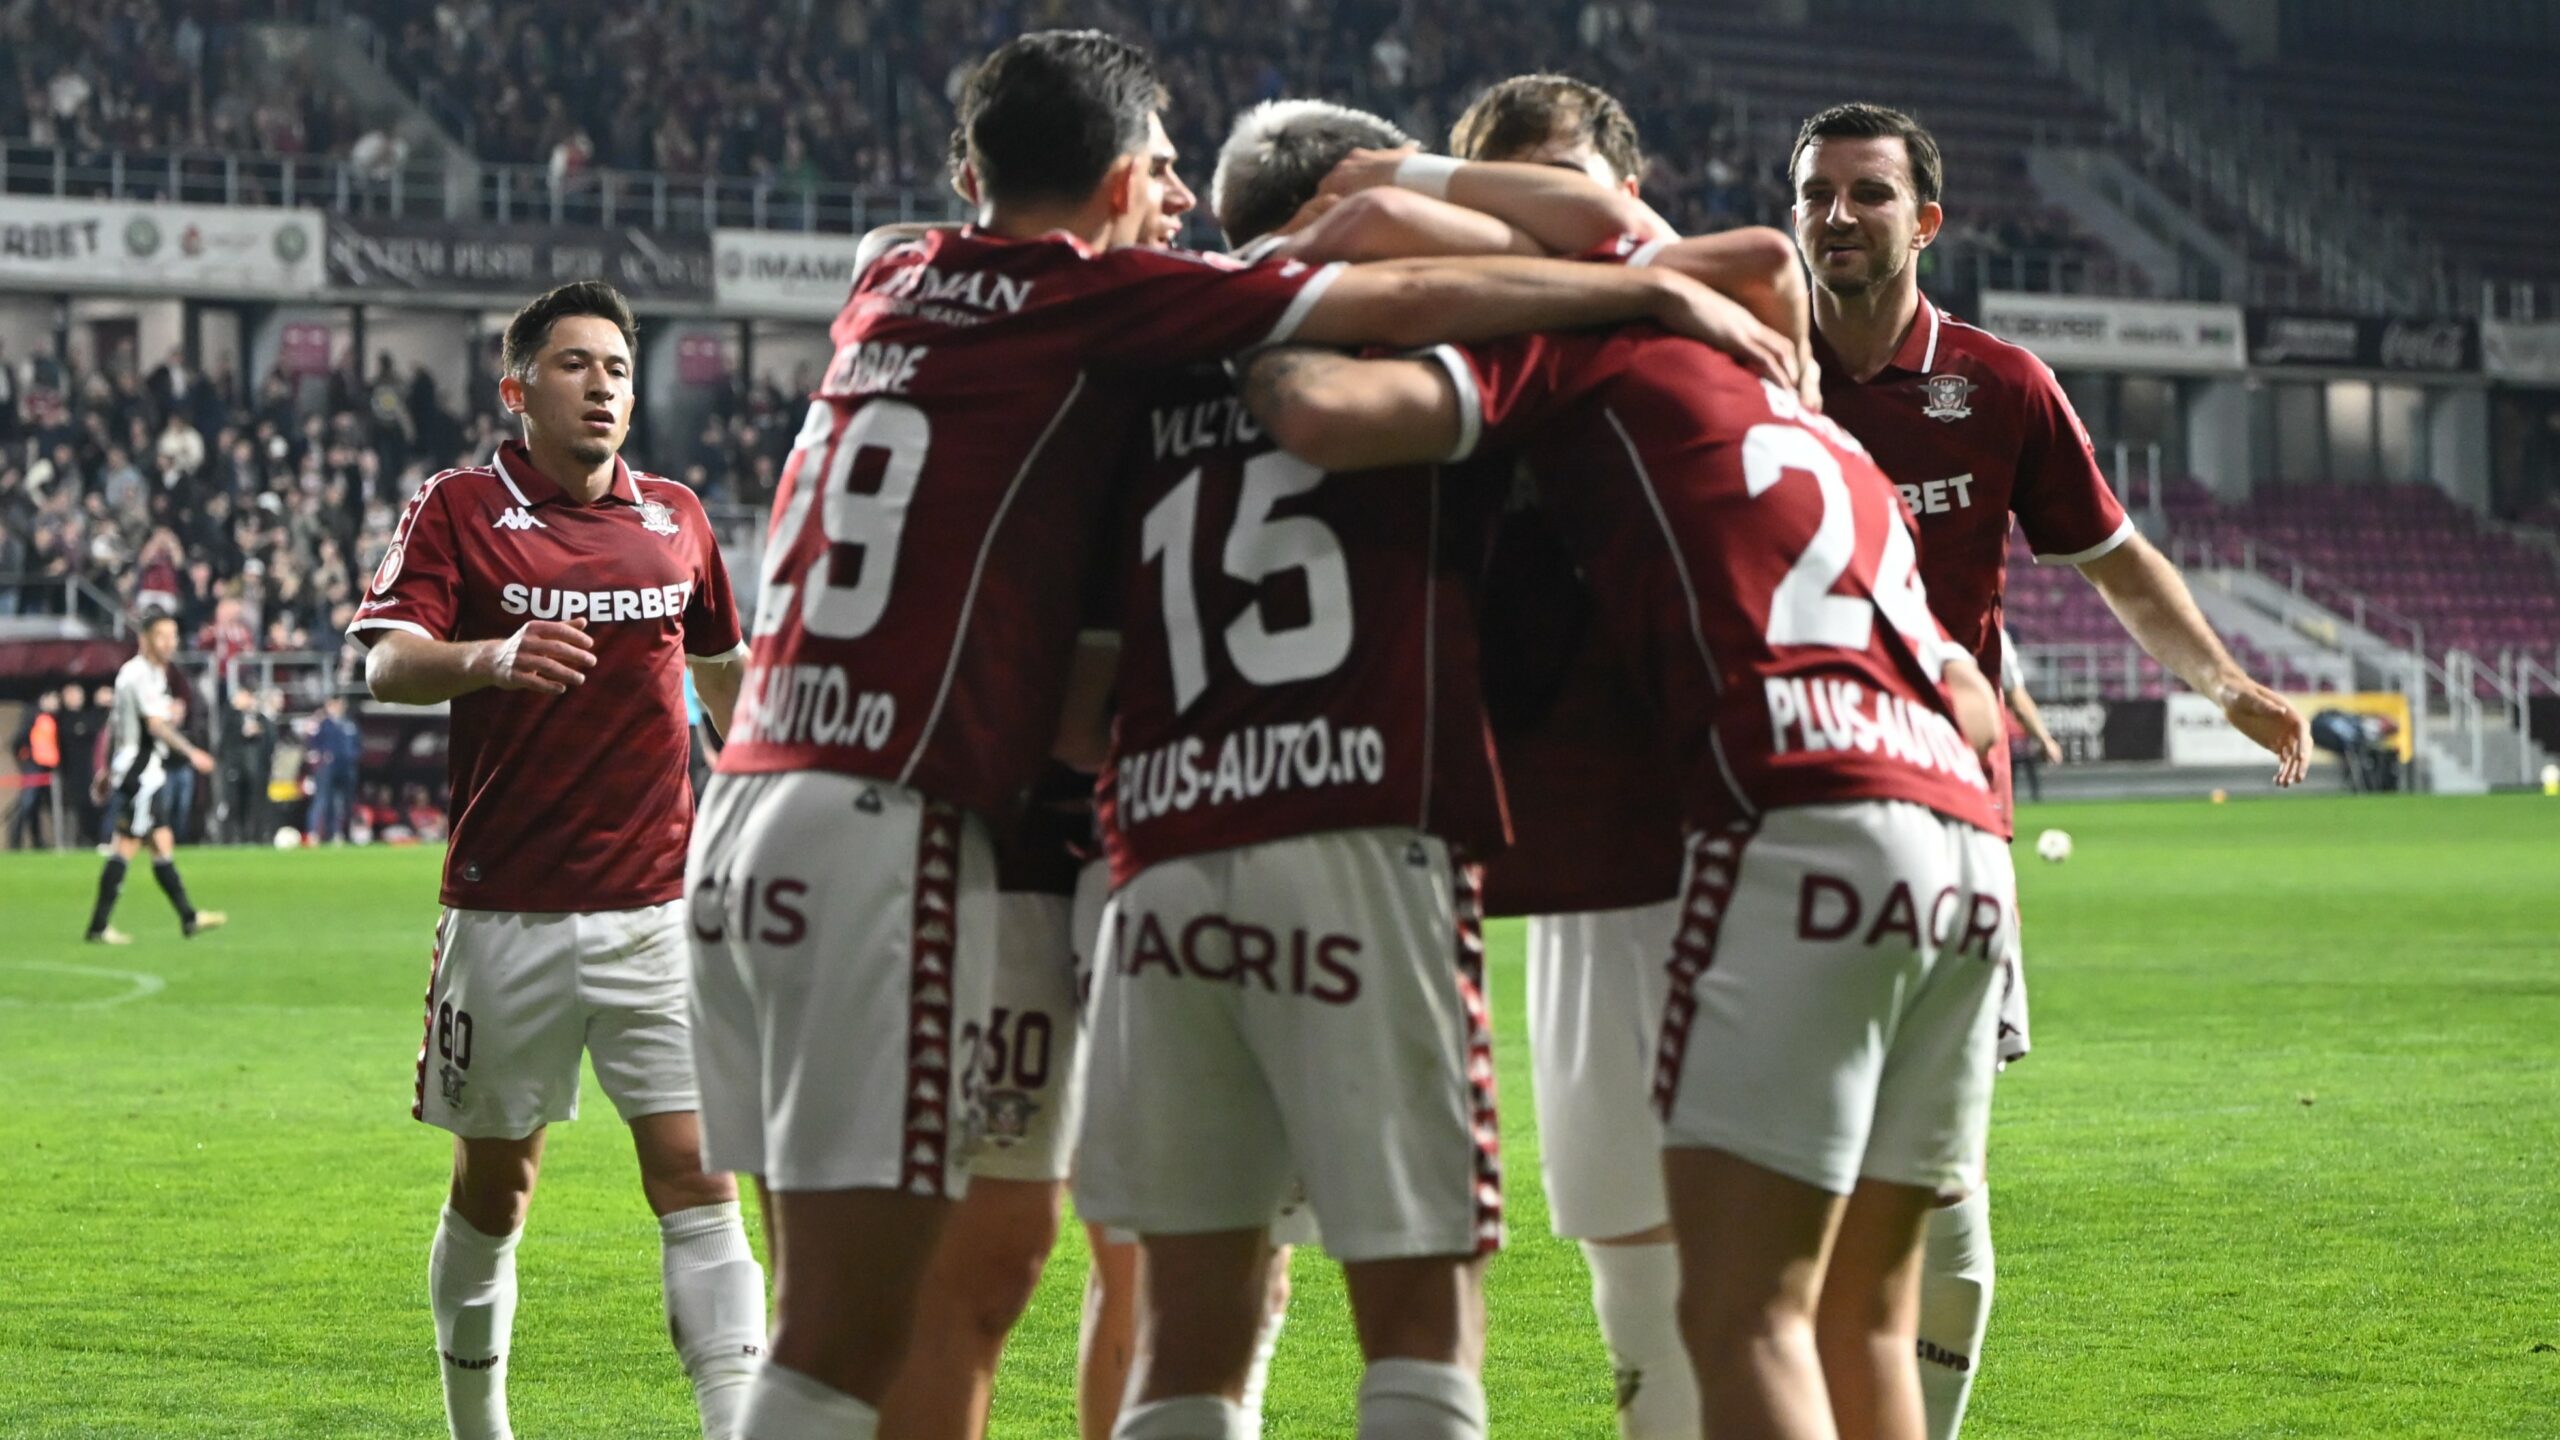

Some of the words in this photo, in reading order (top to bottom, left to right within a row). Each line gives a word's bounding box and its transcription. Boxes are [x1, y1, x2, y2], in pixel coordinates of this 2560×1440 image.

[500, 580, 692, 622] SUPERBET
[1141, 450, 1354, 716] 15
[1742, 424, 1944, 684] 24
[1117, 716, 1385, 831] PLUS-AUTO.ro
